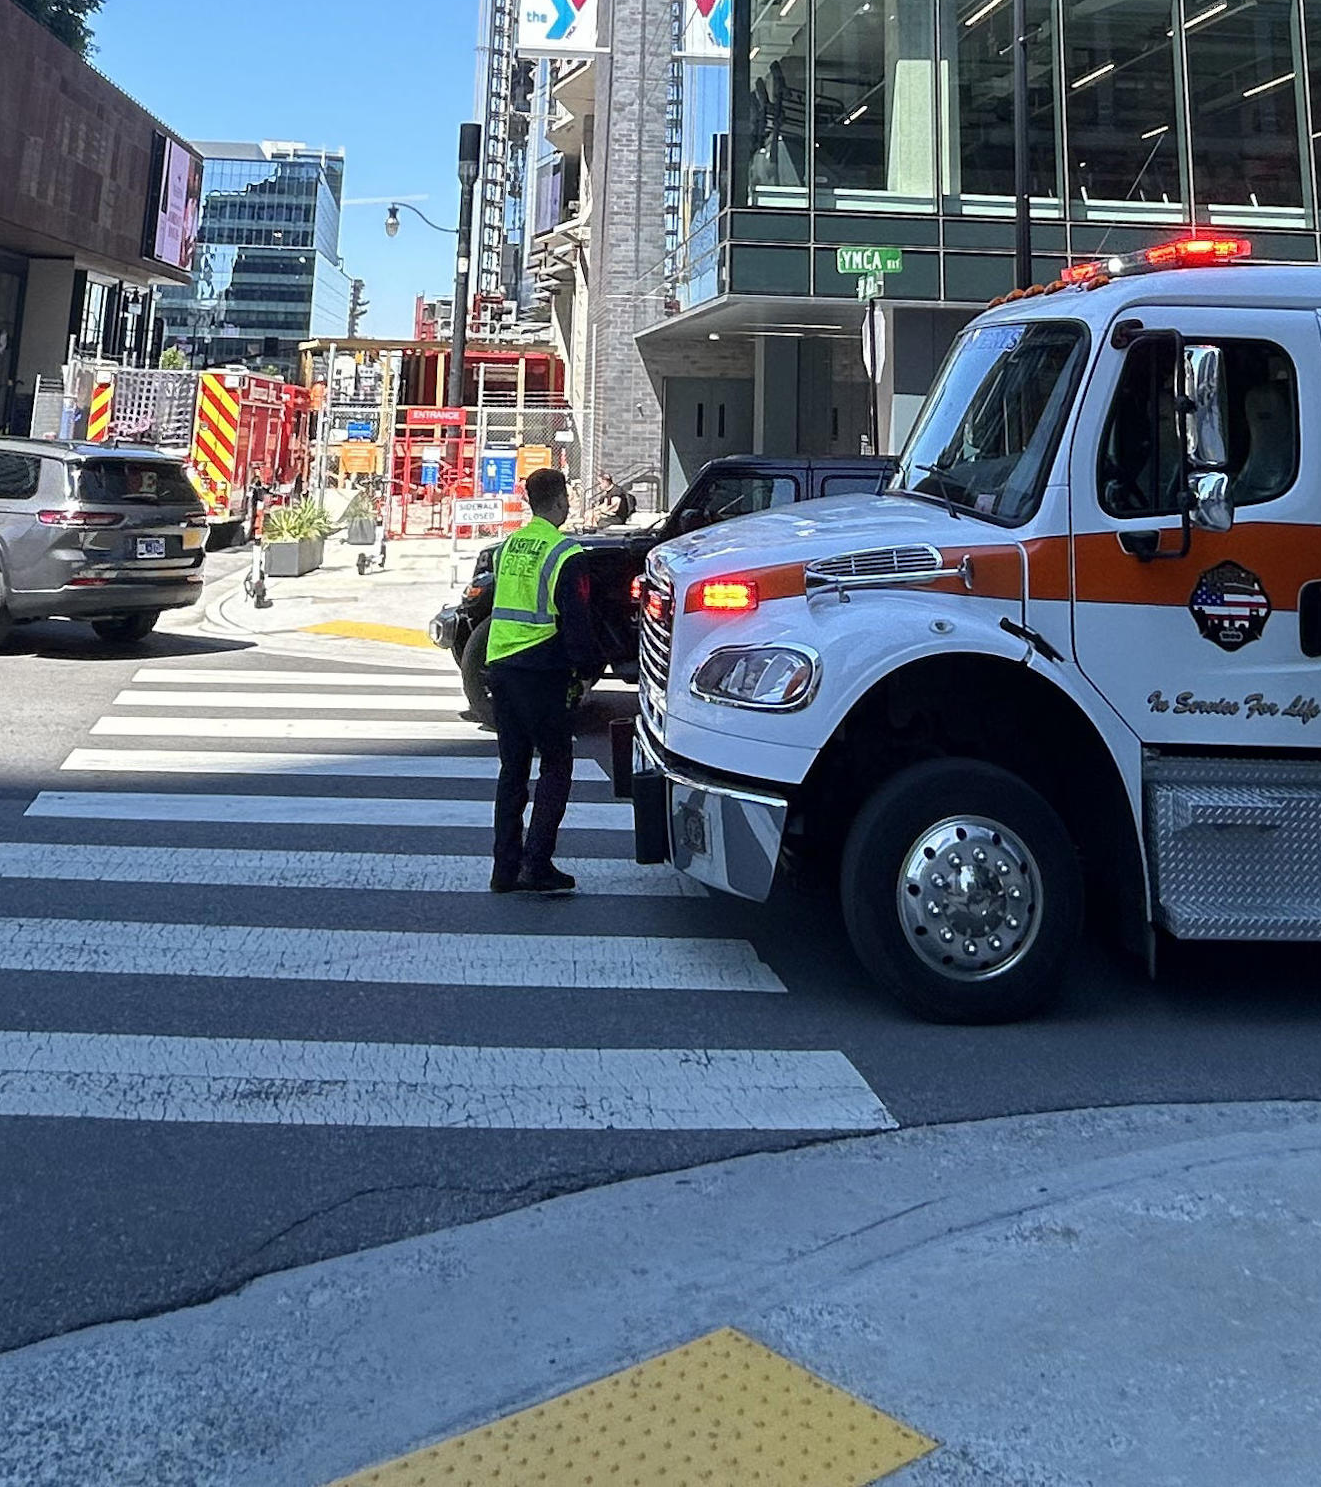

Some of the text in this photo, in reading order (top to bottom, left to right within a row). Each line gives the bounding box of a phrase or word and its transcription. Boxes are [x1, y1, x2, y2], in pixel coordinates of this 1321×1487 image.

[526, 10, 548, 24] the
[841, 249, 883, 270] YMCA
[412, 411, 460, 421] ENTRANCE
[459, 502, 499, 511] SIDEWALK
[462, 513, 495, 521] CLOSED
[1147, 689, 1321, 726] In Service For Life
